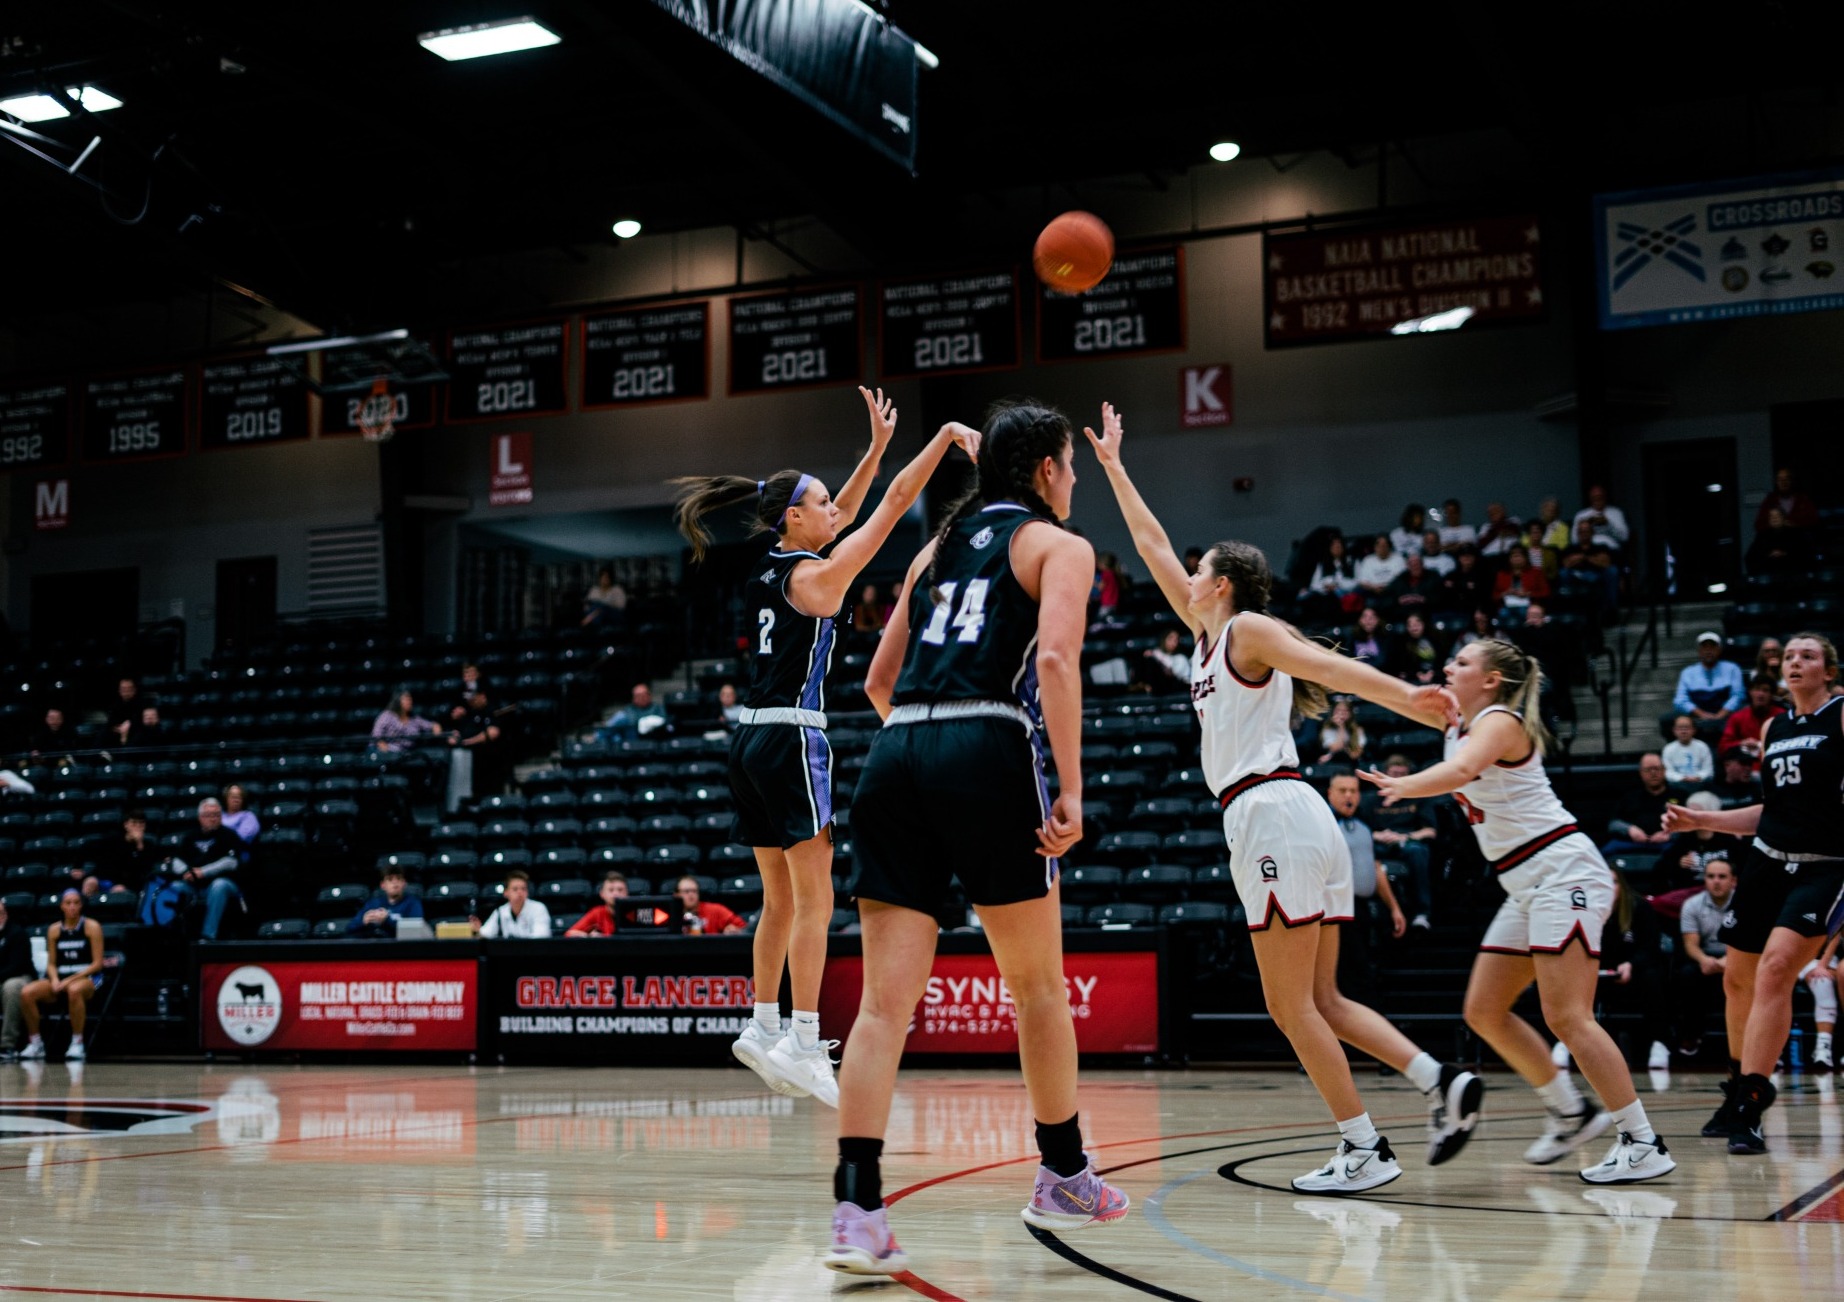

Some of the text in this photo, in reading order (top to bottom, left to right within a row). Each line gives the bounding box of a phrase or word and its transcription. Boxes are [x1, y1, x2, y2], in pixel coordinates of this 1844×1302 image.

[1711, 196, 1843, 228] CROSSROADS
[1324, 227, 1480, 267] NAIA NATIONAL
[1276, 252, 1534, 301] BASKETBALL CHAMPIONS
[1074, 315, 1146, 351] 2021
[1301, 301, 1348, 330] 1992
[761, 347, 829, 384] 2021
[914, 331, 984, 369] 2021
[476, 377, 538, 414] 2021
[612, 362, 676, 399] 2021
[1185, 368, 1224, 412] K
[109, 420, 162, 454] 1995
[226, 407, 284, 442] 2019
[0, 433, 43, 464] 992
[498, 434, 524, 475] L
[35, 478, 70, 519] M
[921, 577, 991, 645] 14
[758, 608, 776, 655] 2
[1770, 754, 1802, 787] 25
[300, 981, 465, 1004] MILLER CATTLE COMPANY
[516, 976, 617, 1009] GRACE
[923, 976, 1097, 1005] SYNEY
[499, 1015, 573, 1034] BUILDING
[576, 1015, 669, 1034] CHAMPIONS
[671, 1016, 694, 1034] OF
[924, 1004, 974, 1019] HVAC
[924, 1019, 1019, 1034] 574-527-1
